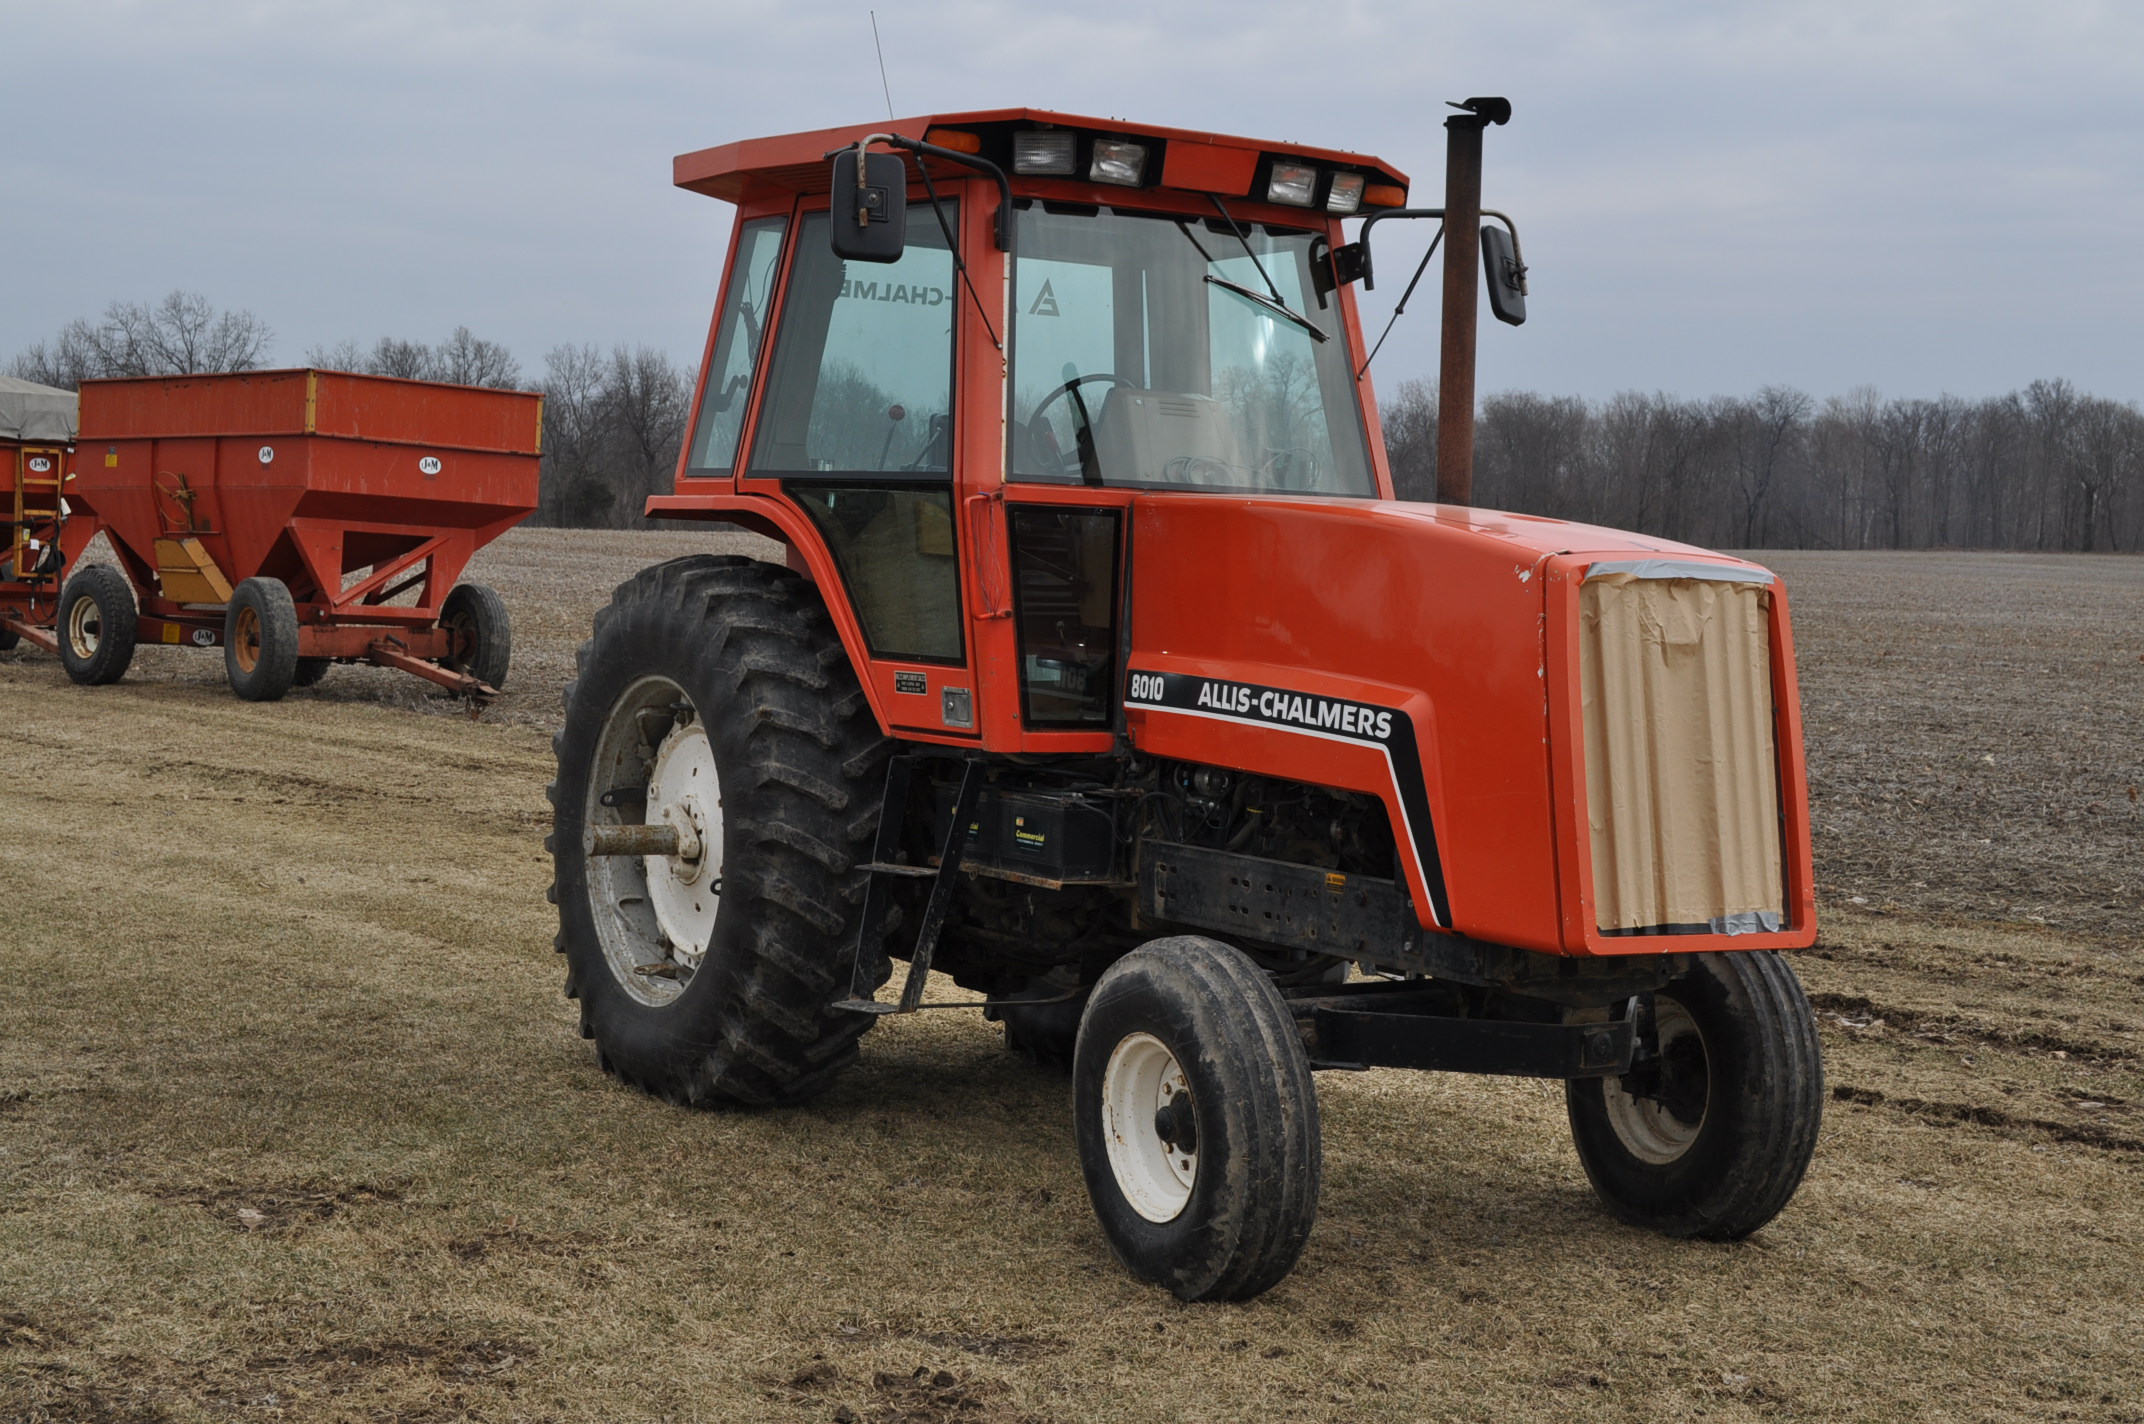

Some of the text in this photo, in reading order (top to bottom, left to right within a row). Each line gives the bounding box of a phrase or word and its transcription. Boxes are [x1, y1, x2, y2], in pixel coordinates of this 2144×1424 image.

[31, 459, 48, 469] J&M
[421, 459, 438, 471] J&M
[194, 631, 213, 642] J&M
[1131, 674, 1392, 739] 8010 ALLIS-CHALMERS
[1016, 829, 1044, 841] Commercial
